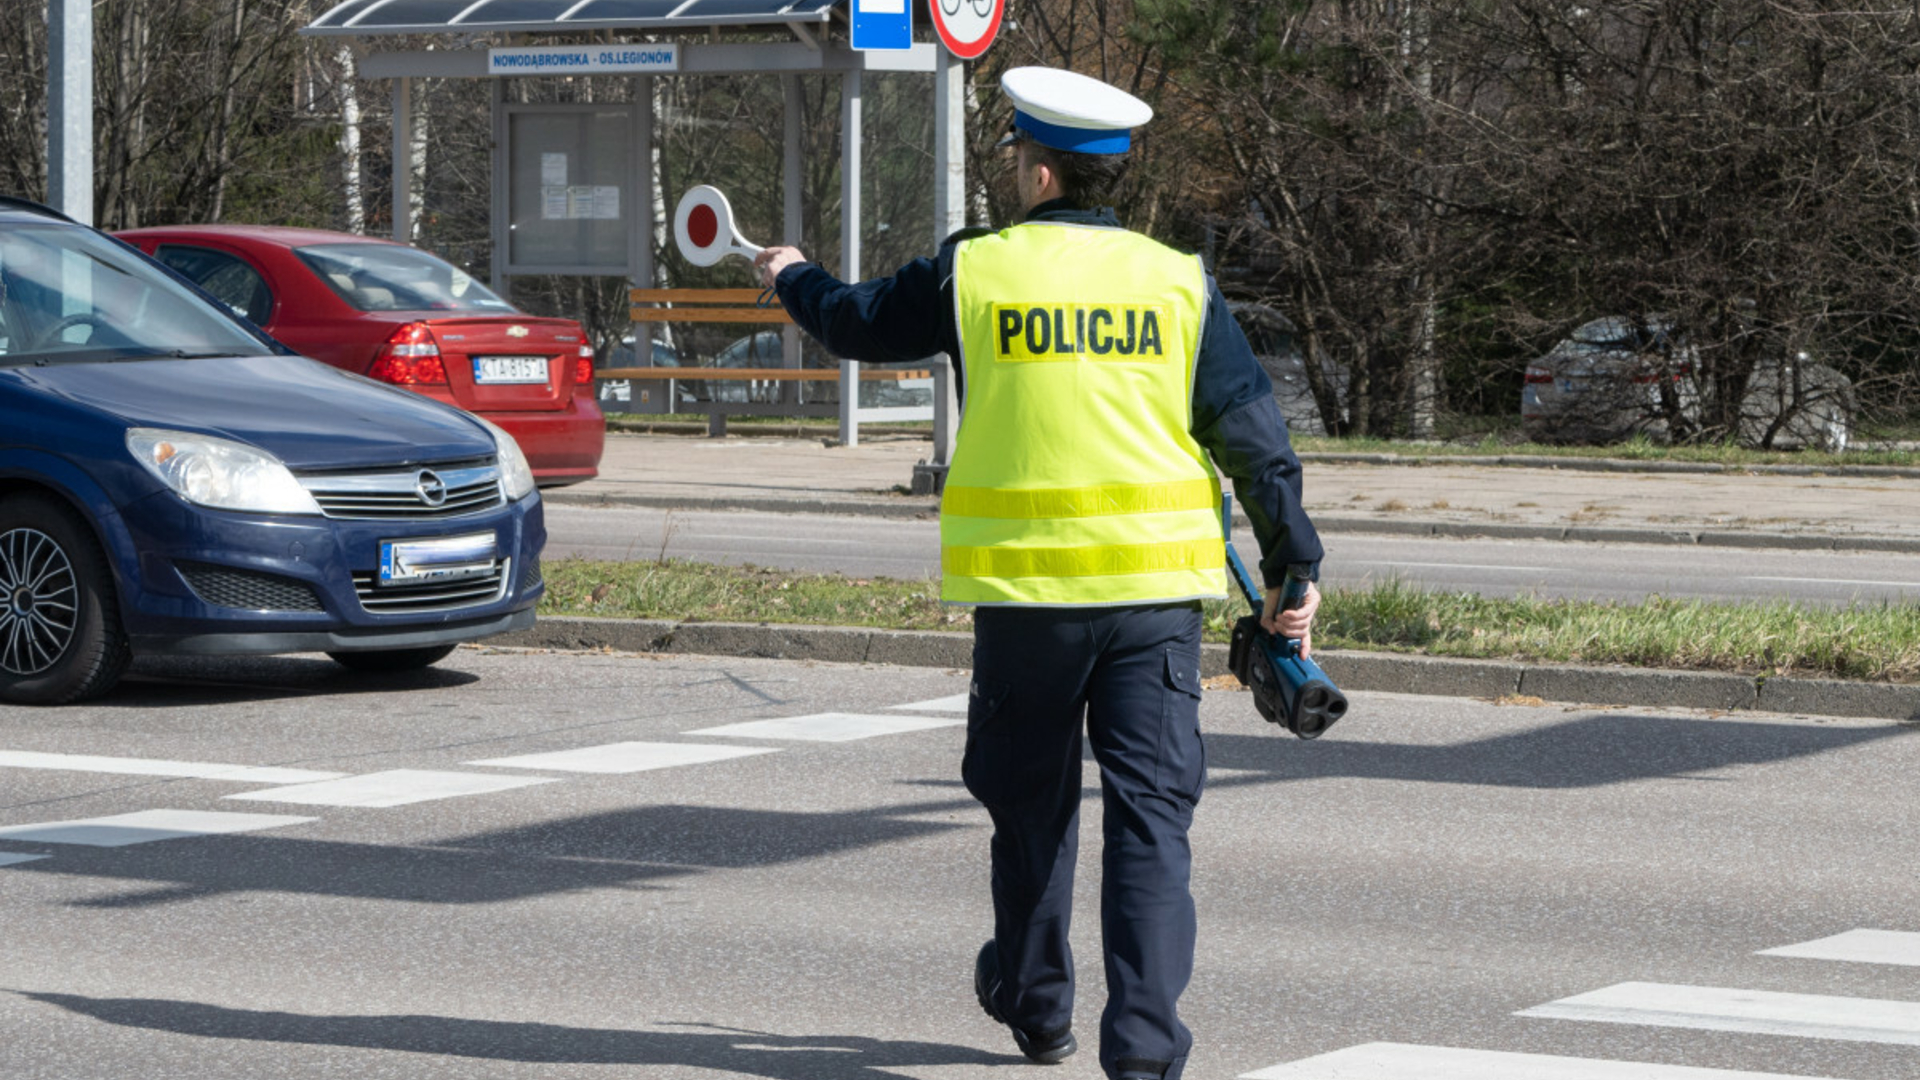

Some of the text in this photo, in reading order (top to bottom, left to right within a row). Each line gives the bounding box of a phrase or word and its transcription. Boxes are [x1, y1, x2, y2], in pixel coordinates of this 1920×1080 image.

[494, 53, 589, 69] NOWODĄBROWSKA
[600, 49, 673, 64] OS.LEGIONÓW
[999, 307, 1162, 355] POLICJA
